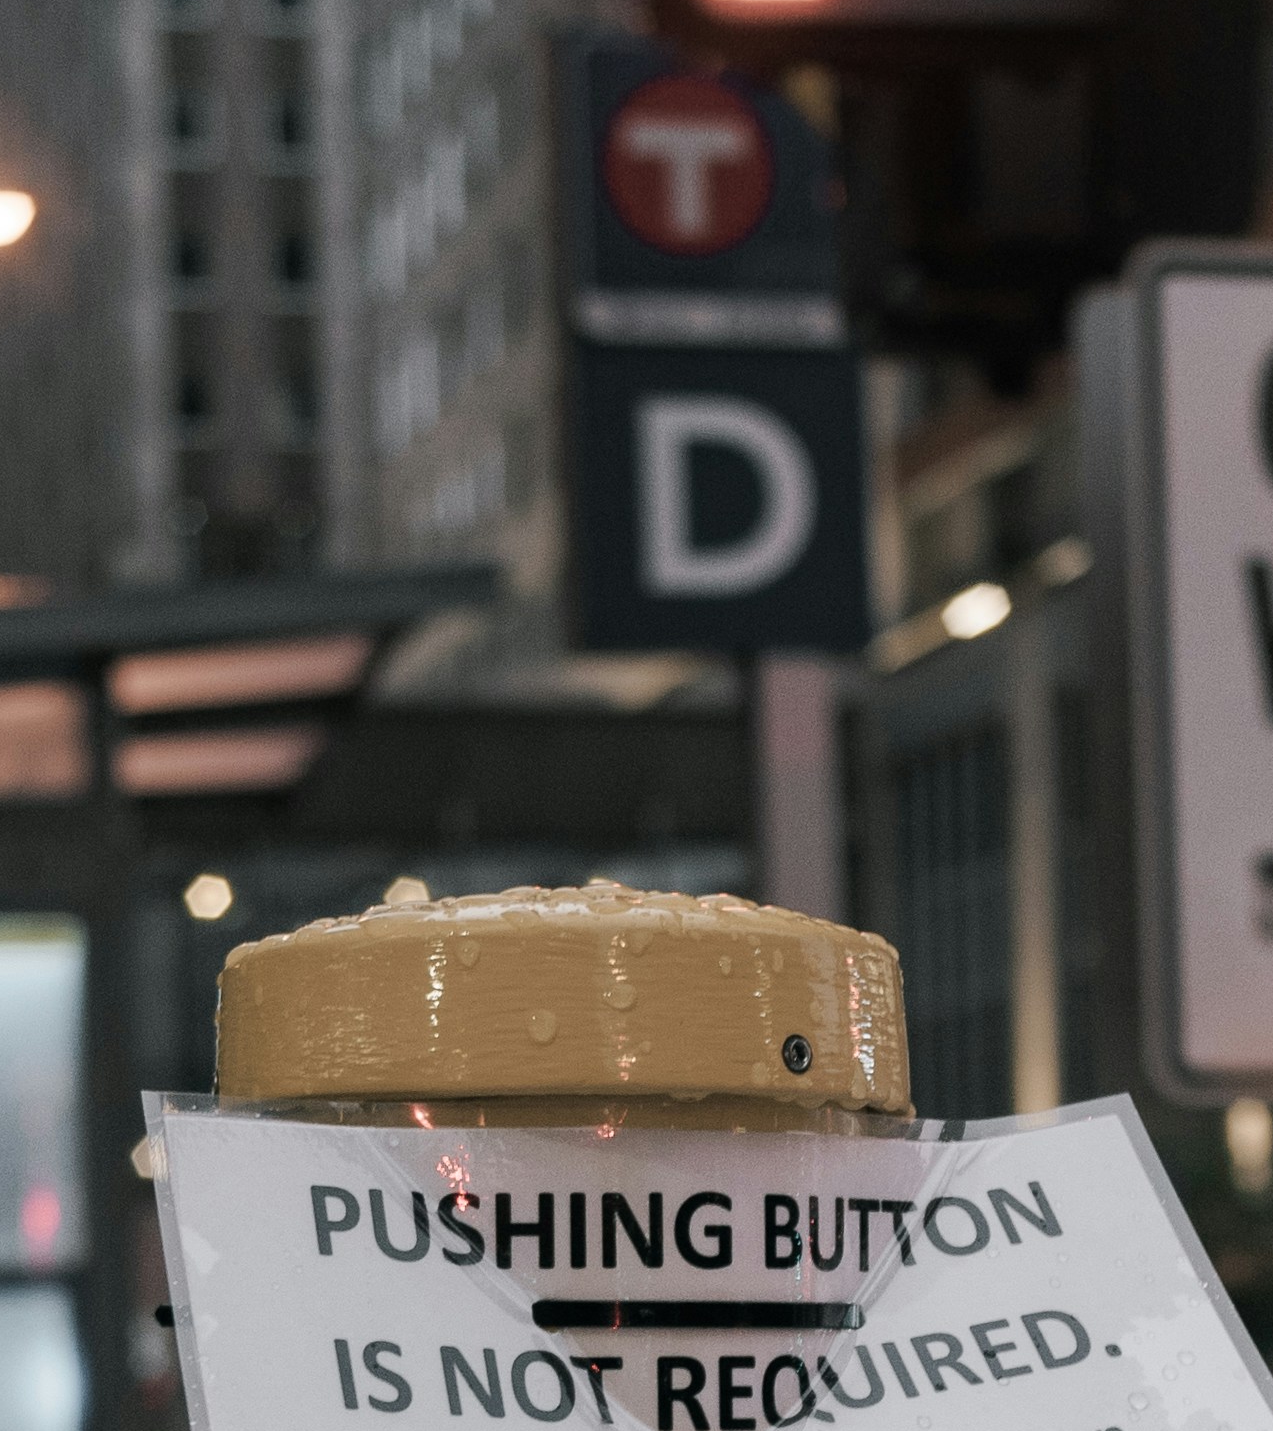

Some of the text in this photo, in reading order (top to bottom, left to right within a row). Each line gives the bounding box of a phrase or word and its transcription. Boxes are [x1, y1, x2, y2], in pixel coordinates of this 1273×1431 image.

[625, 119, 748, 238] T
[638, 394, 819, 596] D
[310, 1181, 1064, 1272] PUSHING BUTTON
[334, 1338, 413, 1414] IS
[439, 1345, 624, 1425] NOT
